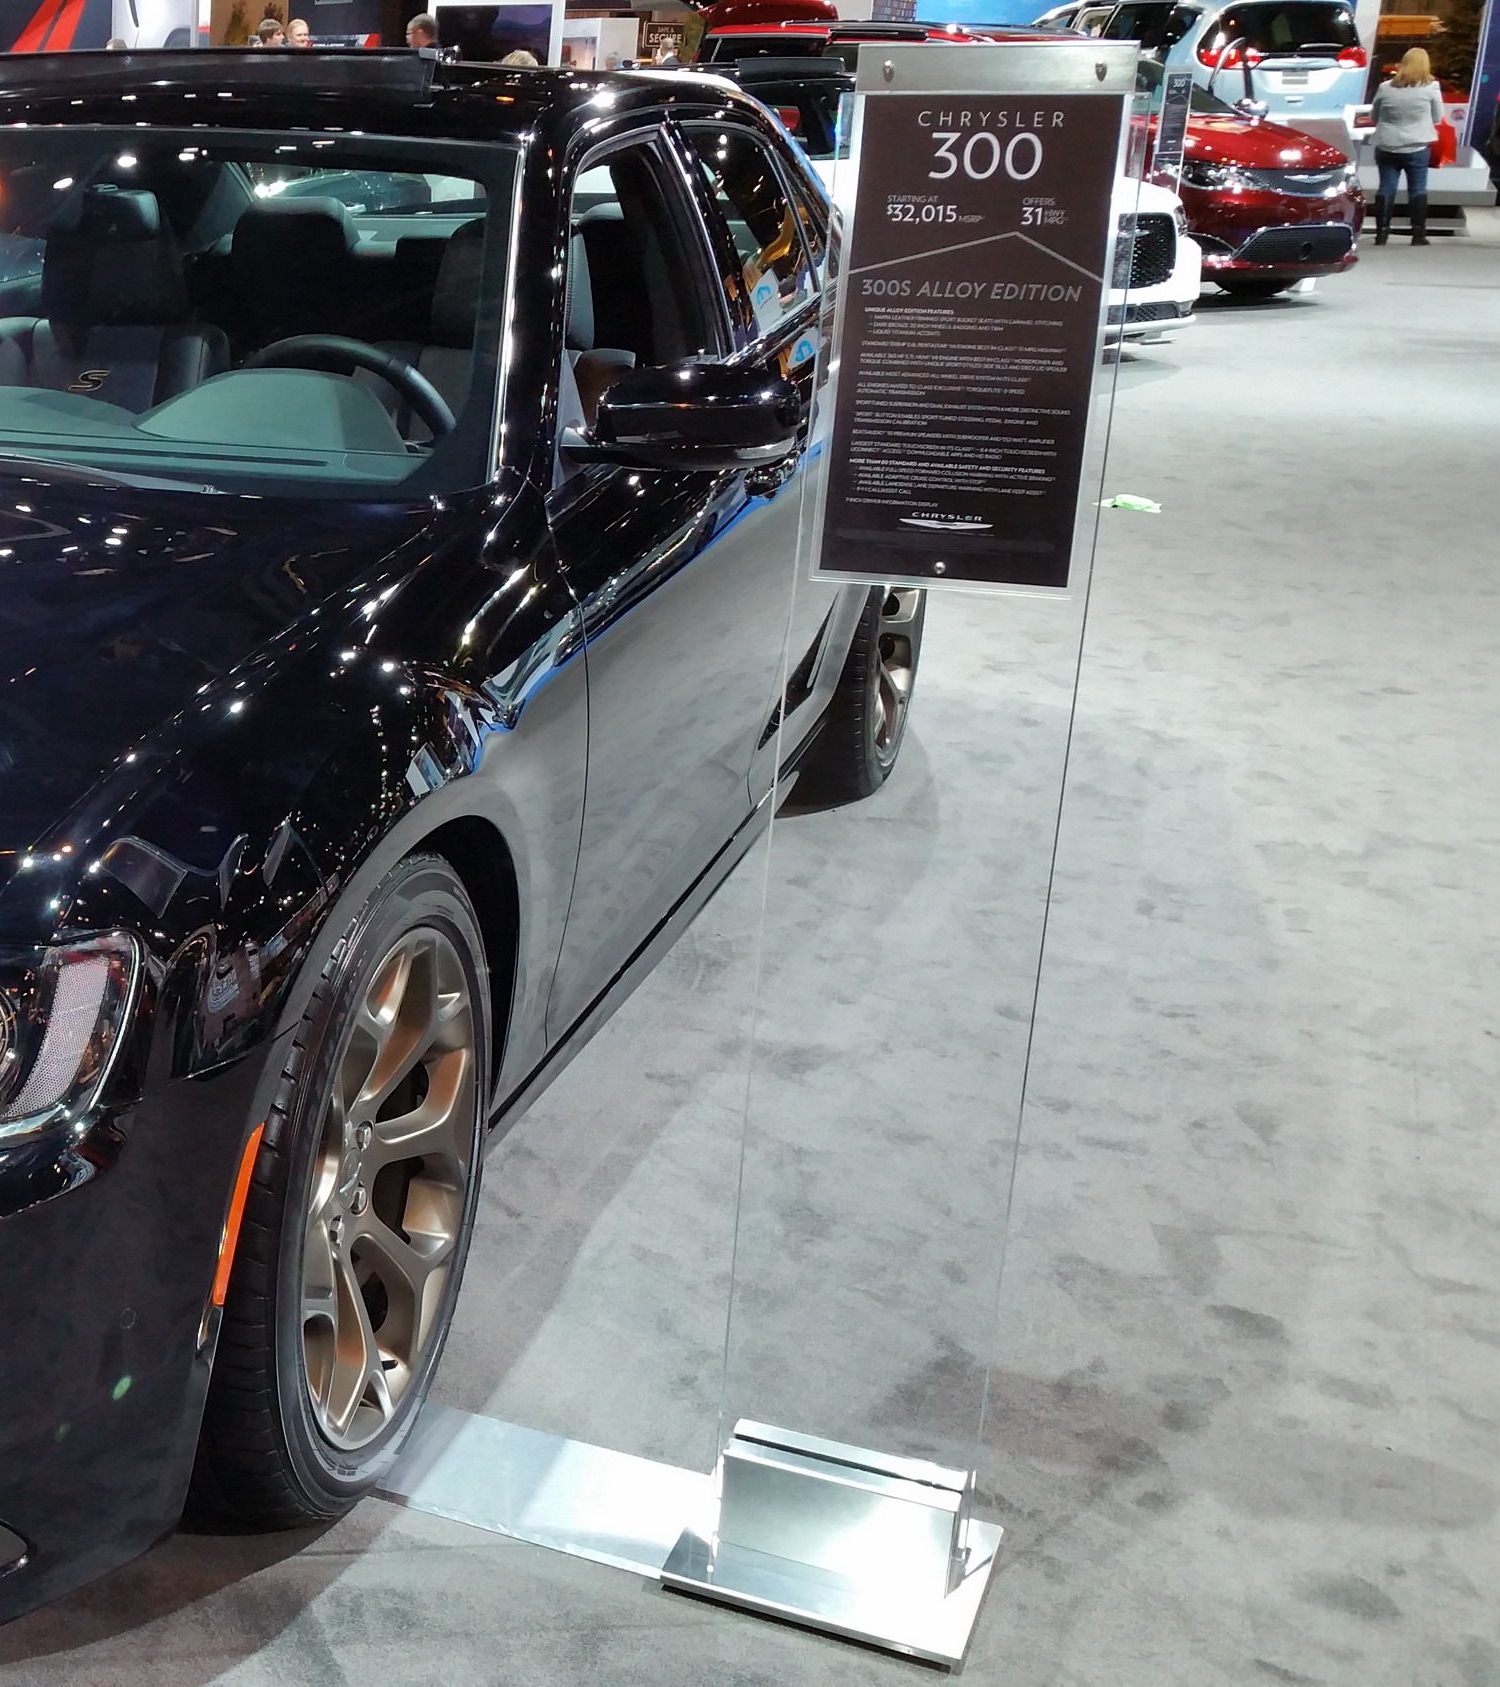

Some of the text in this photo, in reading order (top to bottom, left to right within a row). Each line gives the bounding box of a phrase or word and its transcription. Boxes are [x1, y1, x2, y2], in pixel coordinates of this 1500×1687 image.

[918, 111, 1065, 128] CHRYSLER
[928, 132, 1043, 181] 300
[887, 194, 939, 204] STARTING AT
[886, 204, 958, 225] $32,015
[1021, 207, 1066, 226] 31 HWY
[861, 279, 1083, 302] 300S ALLOY EDITION
[67, 369, 110, 392] S
[911, 511, 983, 521] CHRYSLER
